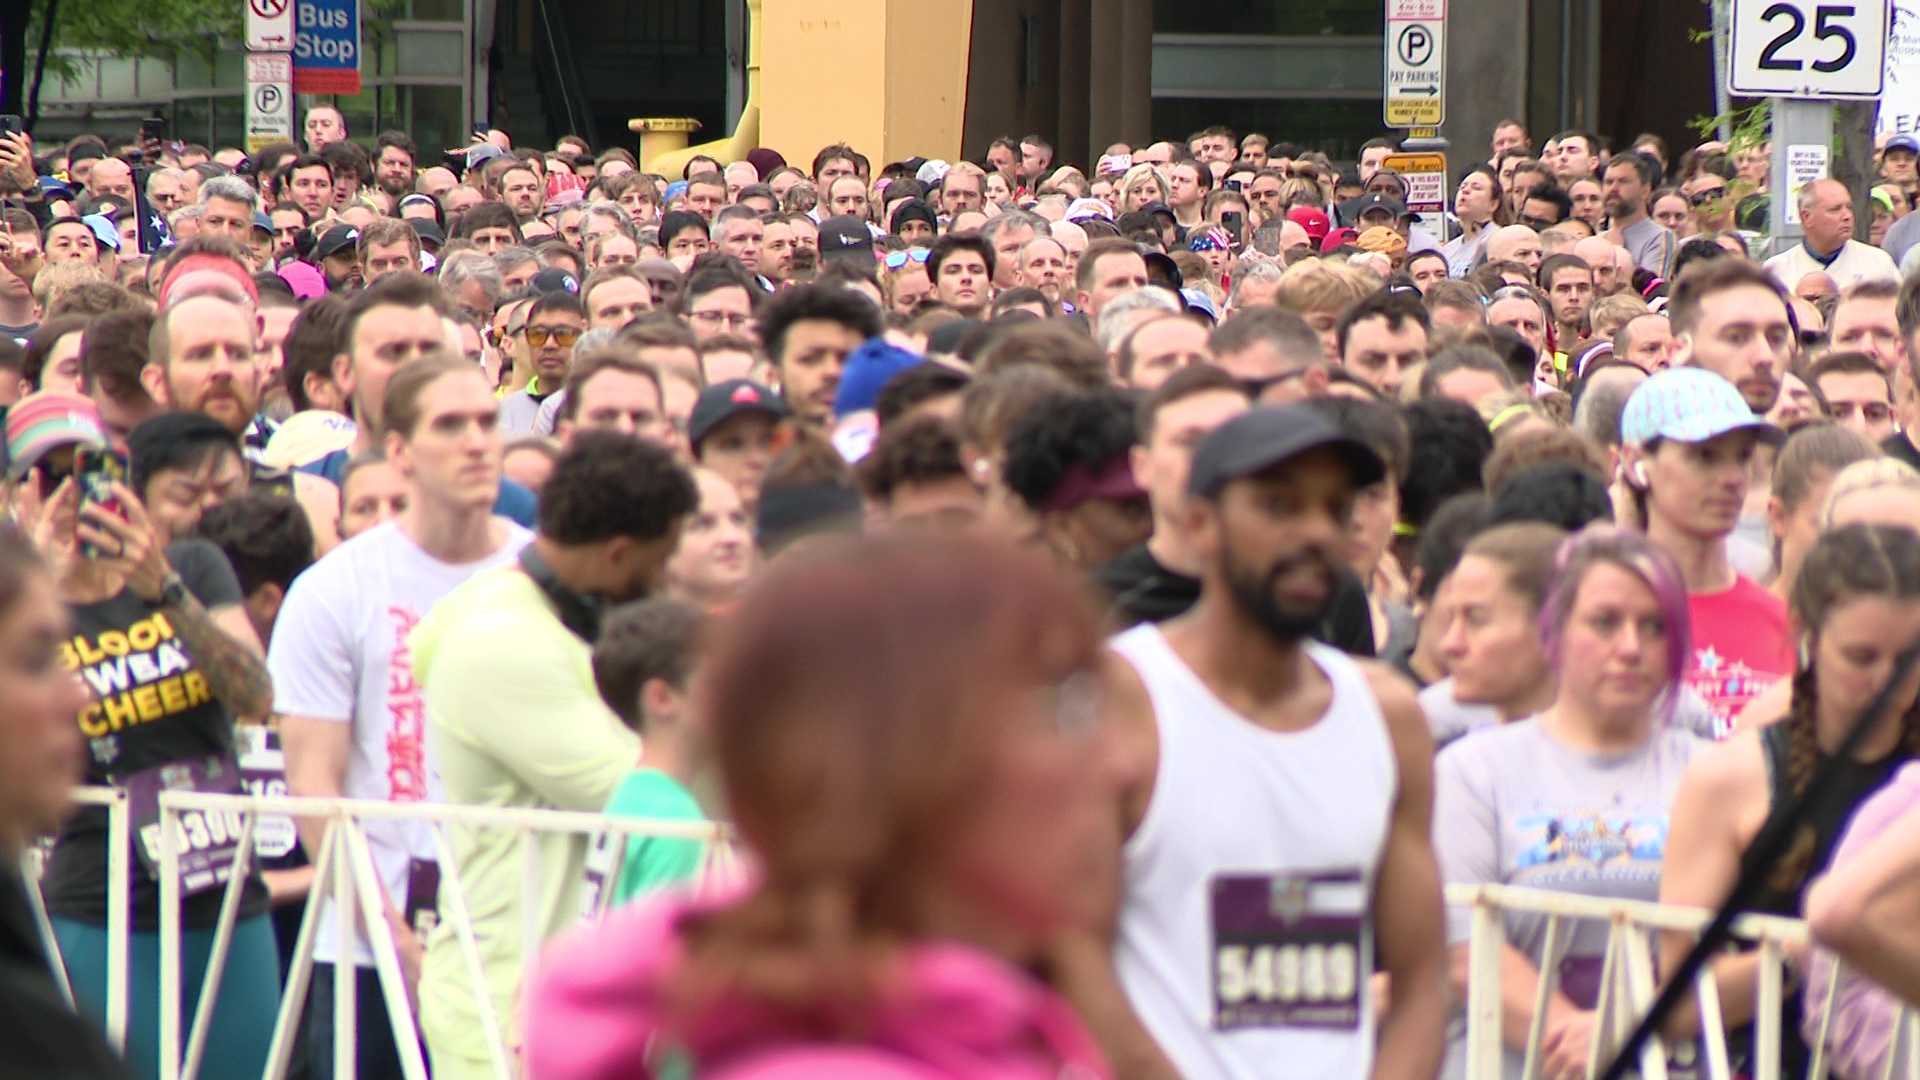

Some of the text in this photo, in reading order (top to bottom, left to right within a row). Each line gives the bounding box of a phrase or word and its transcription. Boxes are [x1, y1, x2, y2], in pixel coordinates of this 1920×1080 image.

[300, 3, 349, 28] Bus
[294, 32, 355, 63] Stop
[1758, 3, 1857, 73] 25
[1390, 71, 1440, 82] PAY PARKING
